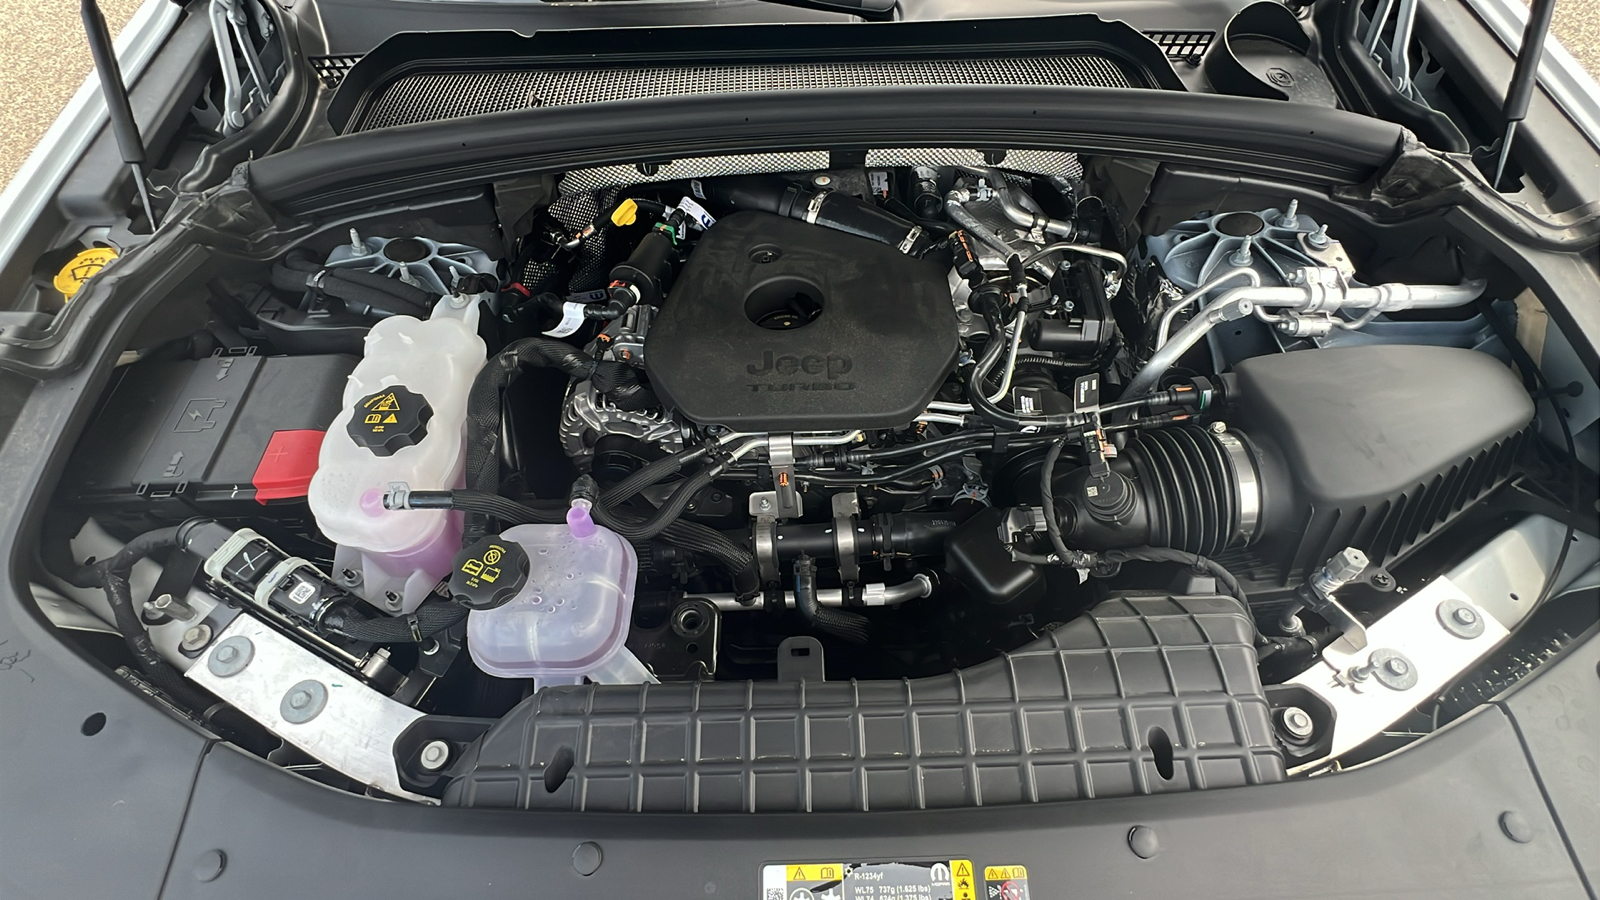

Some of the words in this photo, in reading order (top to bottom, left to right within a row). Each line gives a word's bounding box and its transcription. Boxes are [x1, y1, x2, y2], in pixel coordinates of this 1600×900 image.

[746, 350, 853, 380] Jeep
[746, 382, 856, 392] TURBO
[854, 871, 884, 881] R-1234yf
[854, 886, 874, 894] WL75
[878, 885, 895, 895] 737g
